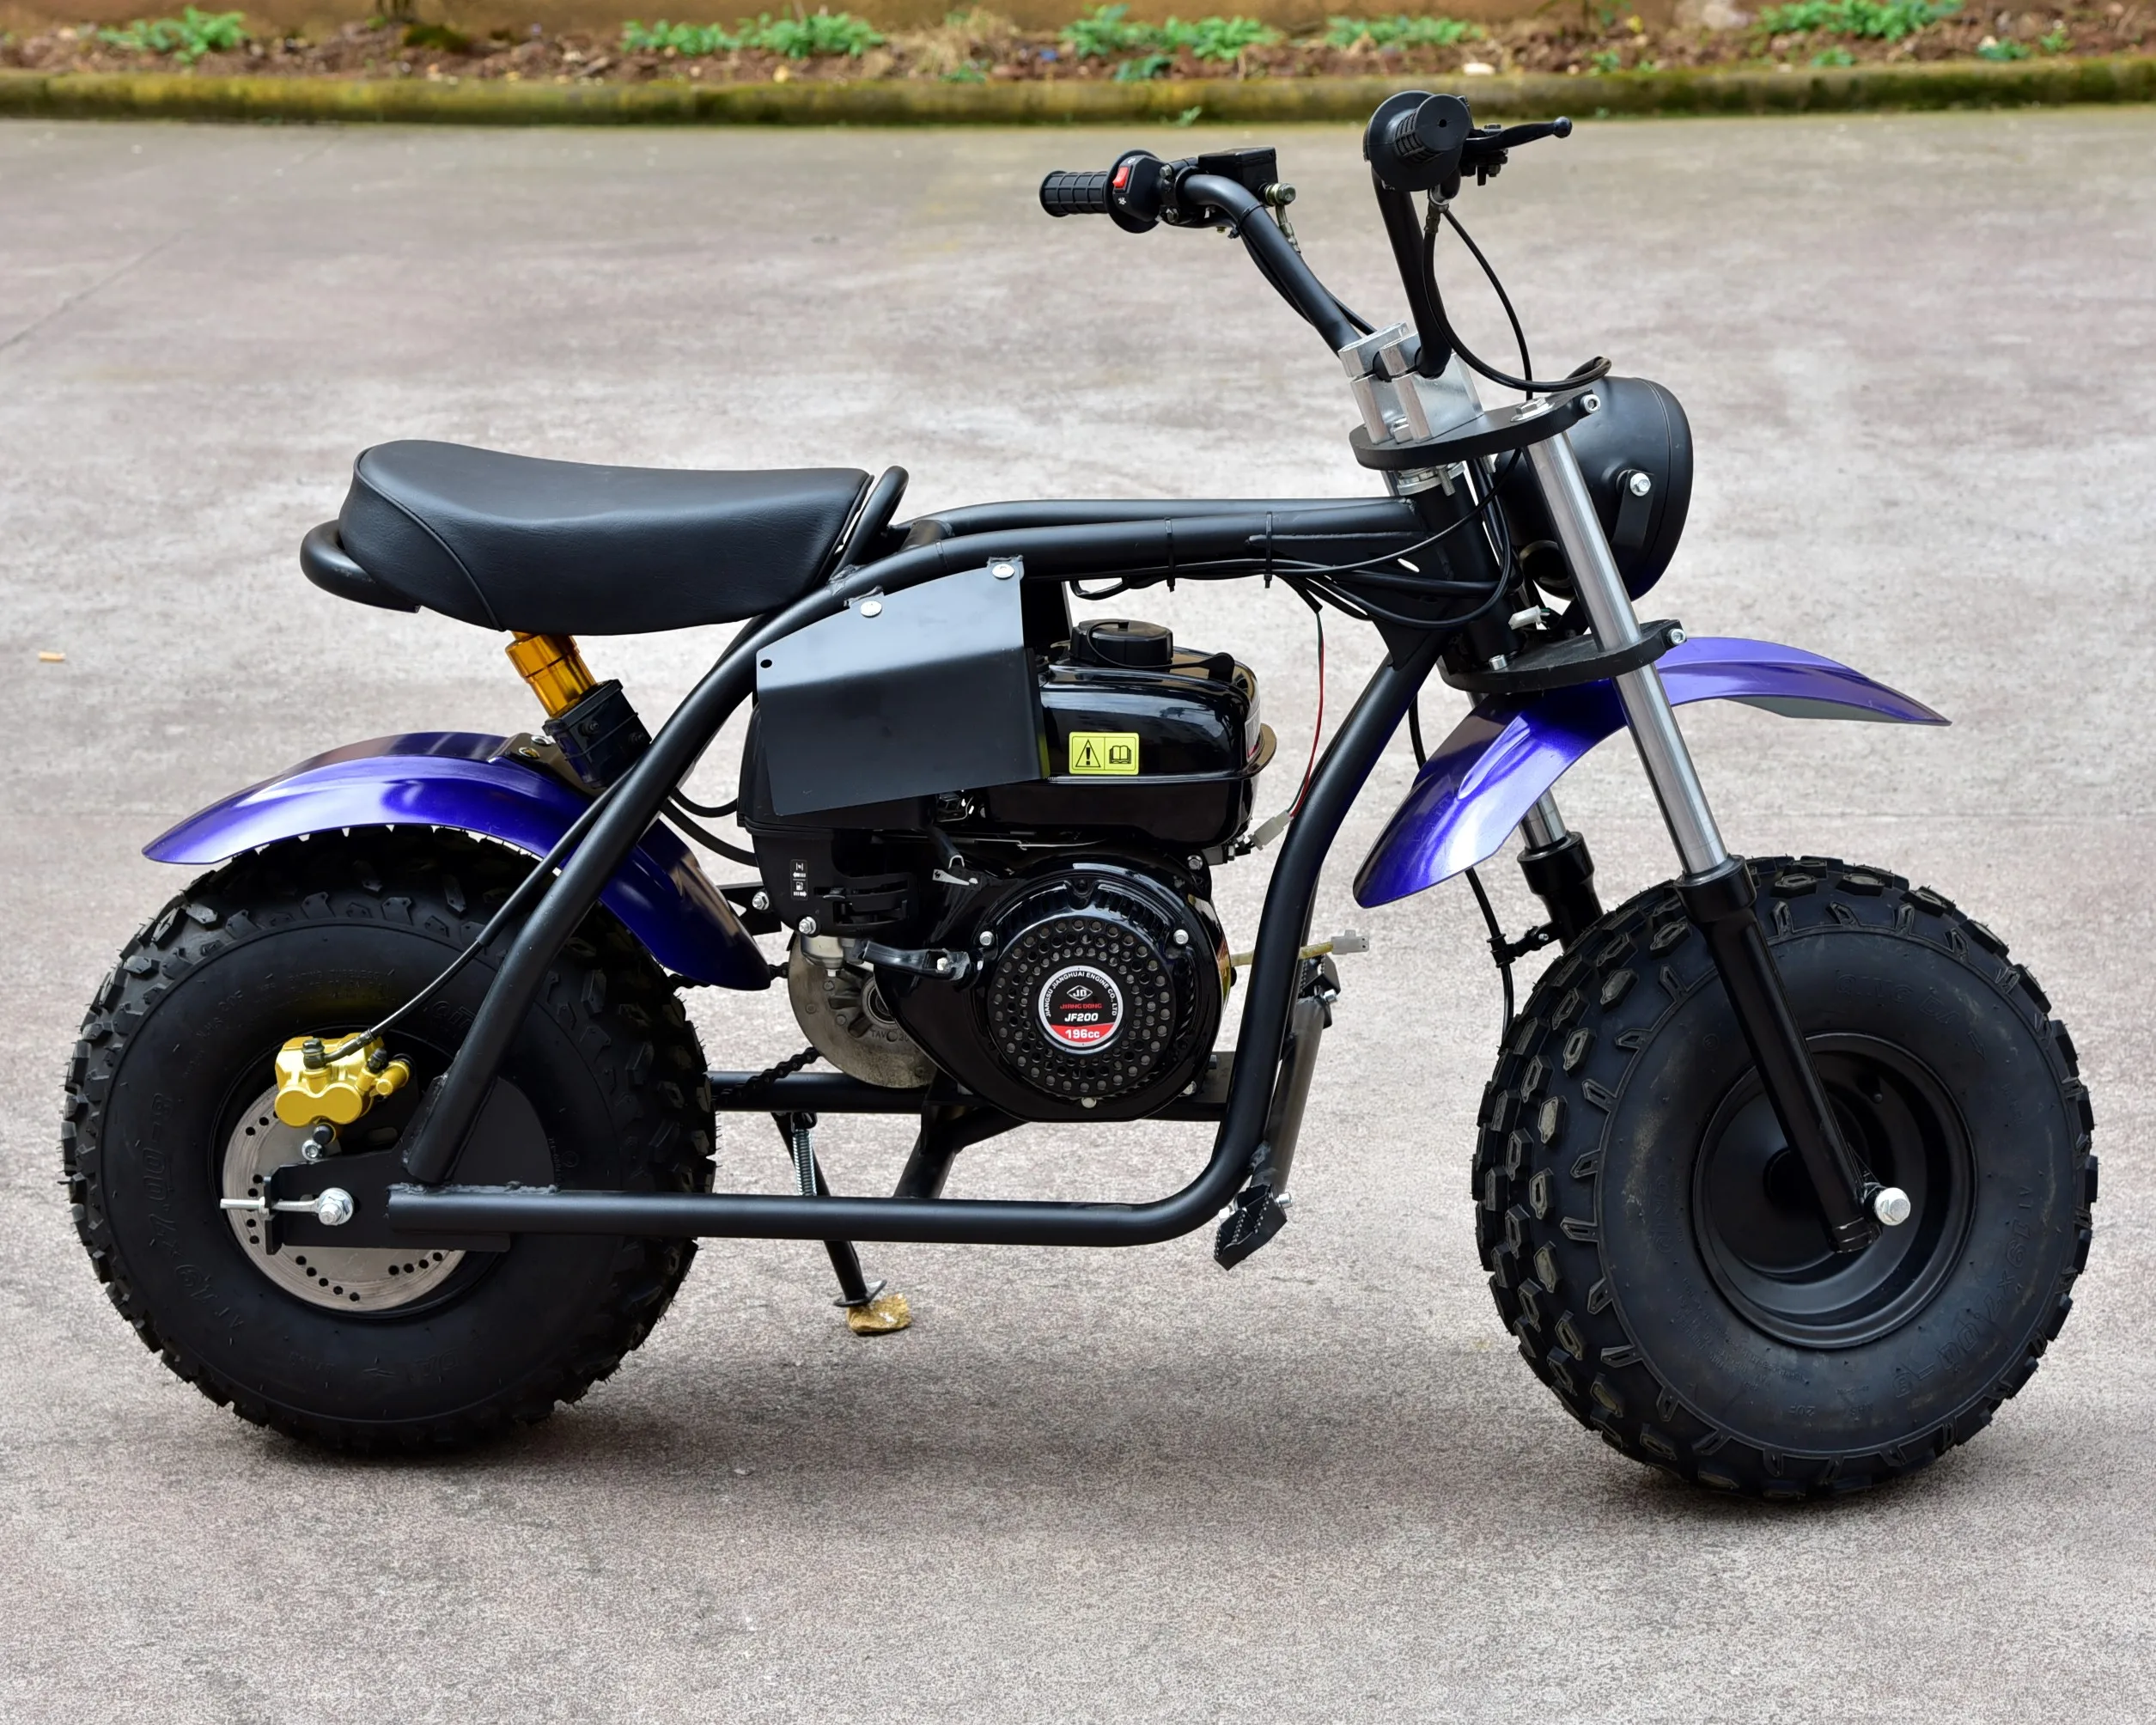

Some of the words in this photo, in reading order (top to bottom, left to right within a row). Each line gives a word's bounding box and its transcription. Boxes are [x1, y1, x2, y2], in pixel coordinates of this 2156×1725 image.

[1044, 989, 1053, 1017] JIANGSU
[1051, 971, 1085, 990] JIANGHUAI
[1085, 972, 1110, 989] ENGINE
[1064, 1012, 1099, 1022] JF200
[871, 1030, 887, 1039] TAV
[1065, 1028, 1100, 1039] 196cc
